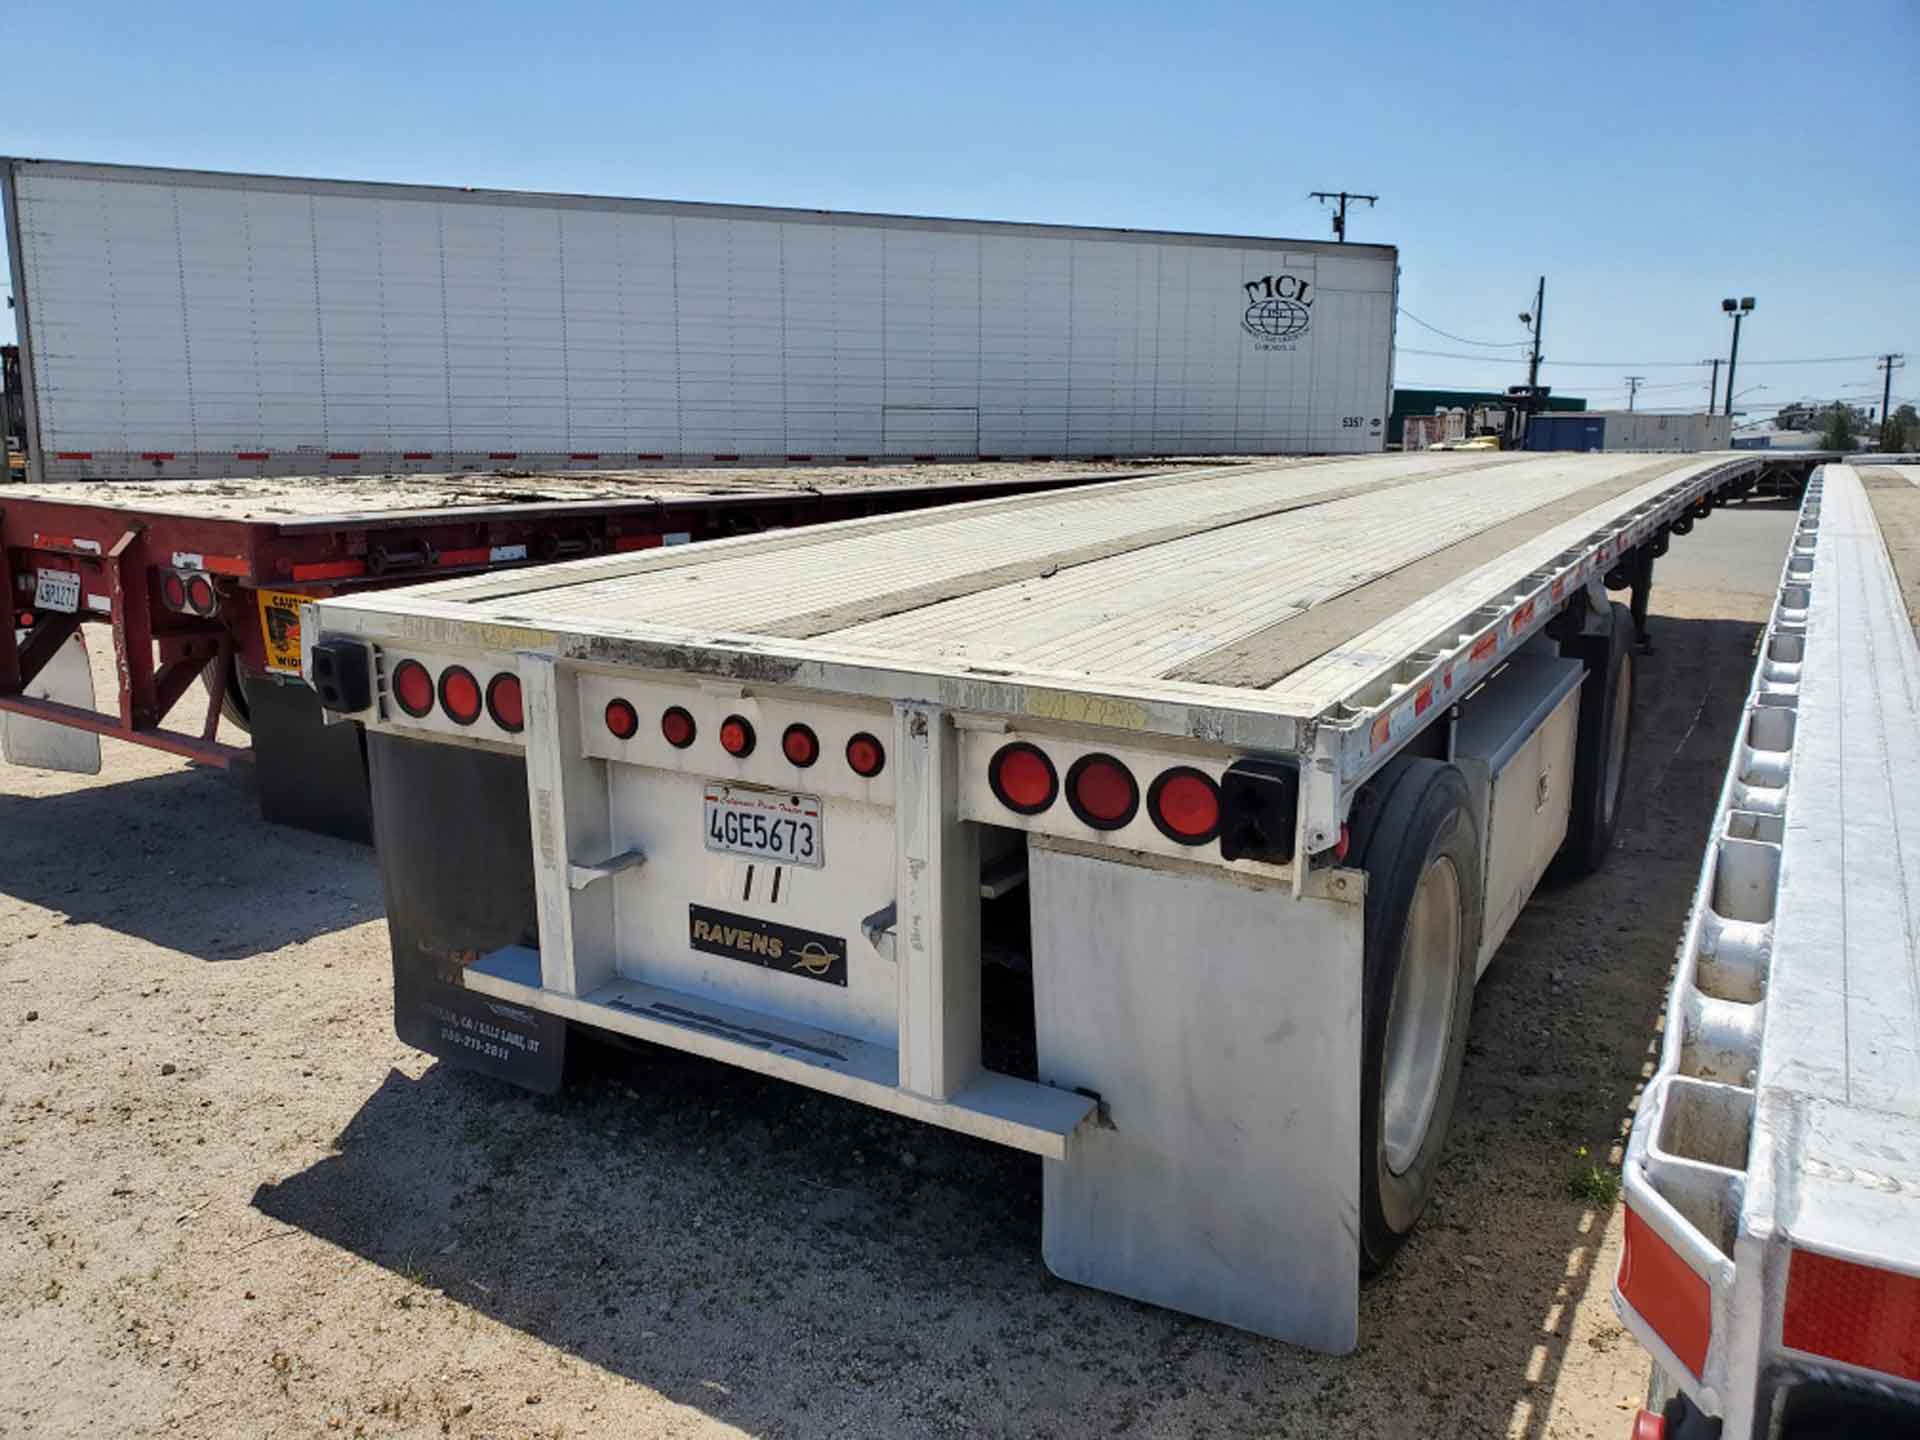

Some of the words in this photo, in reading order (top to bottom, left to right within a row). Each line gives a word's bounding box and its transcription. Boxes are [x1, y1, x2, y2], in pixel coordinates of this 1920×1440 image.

[1244, 275, 1314, 307] MCL
[710, 808, 814, 857] 4GE5673
[692, 918, 784, 960] RAVENS
